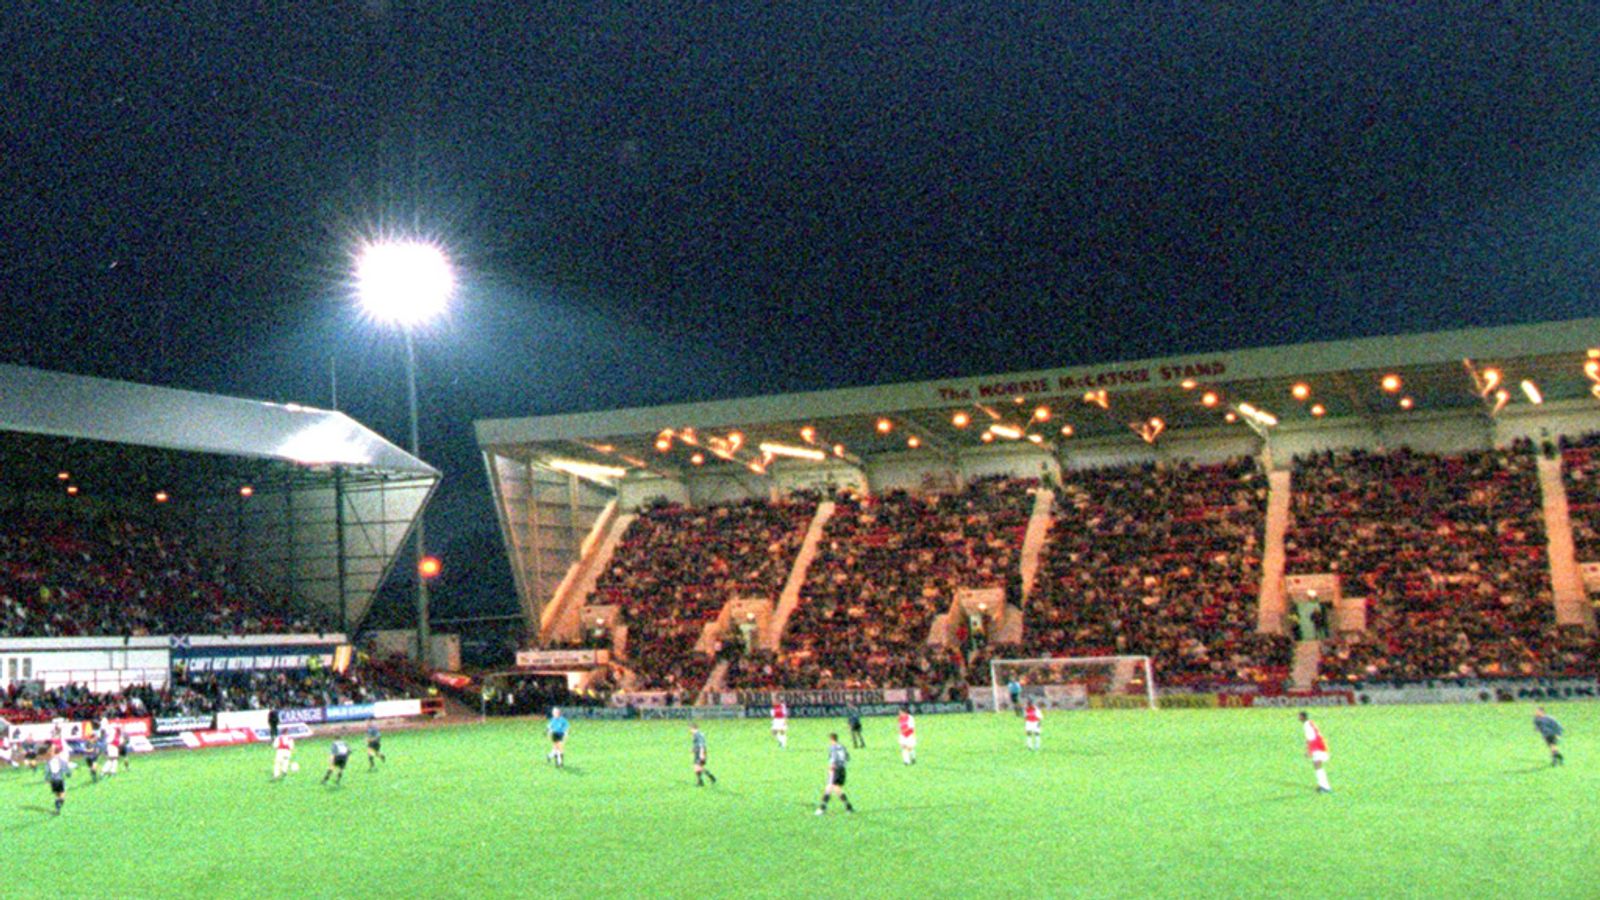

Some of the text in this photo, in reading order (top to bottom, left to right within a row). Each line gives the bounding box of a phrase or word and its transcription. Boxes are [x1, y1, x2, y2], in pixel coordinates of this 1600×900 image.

[938, 388, 972, 400] The
[1160, 362, 1226, 380] STAND
[1253, 693, 1347, 707] McDonald's
[278, 708, 322, 723] CARNEGIE
